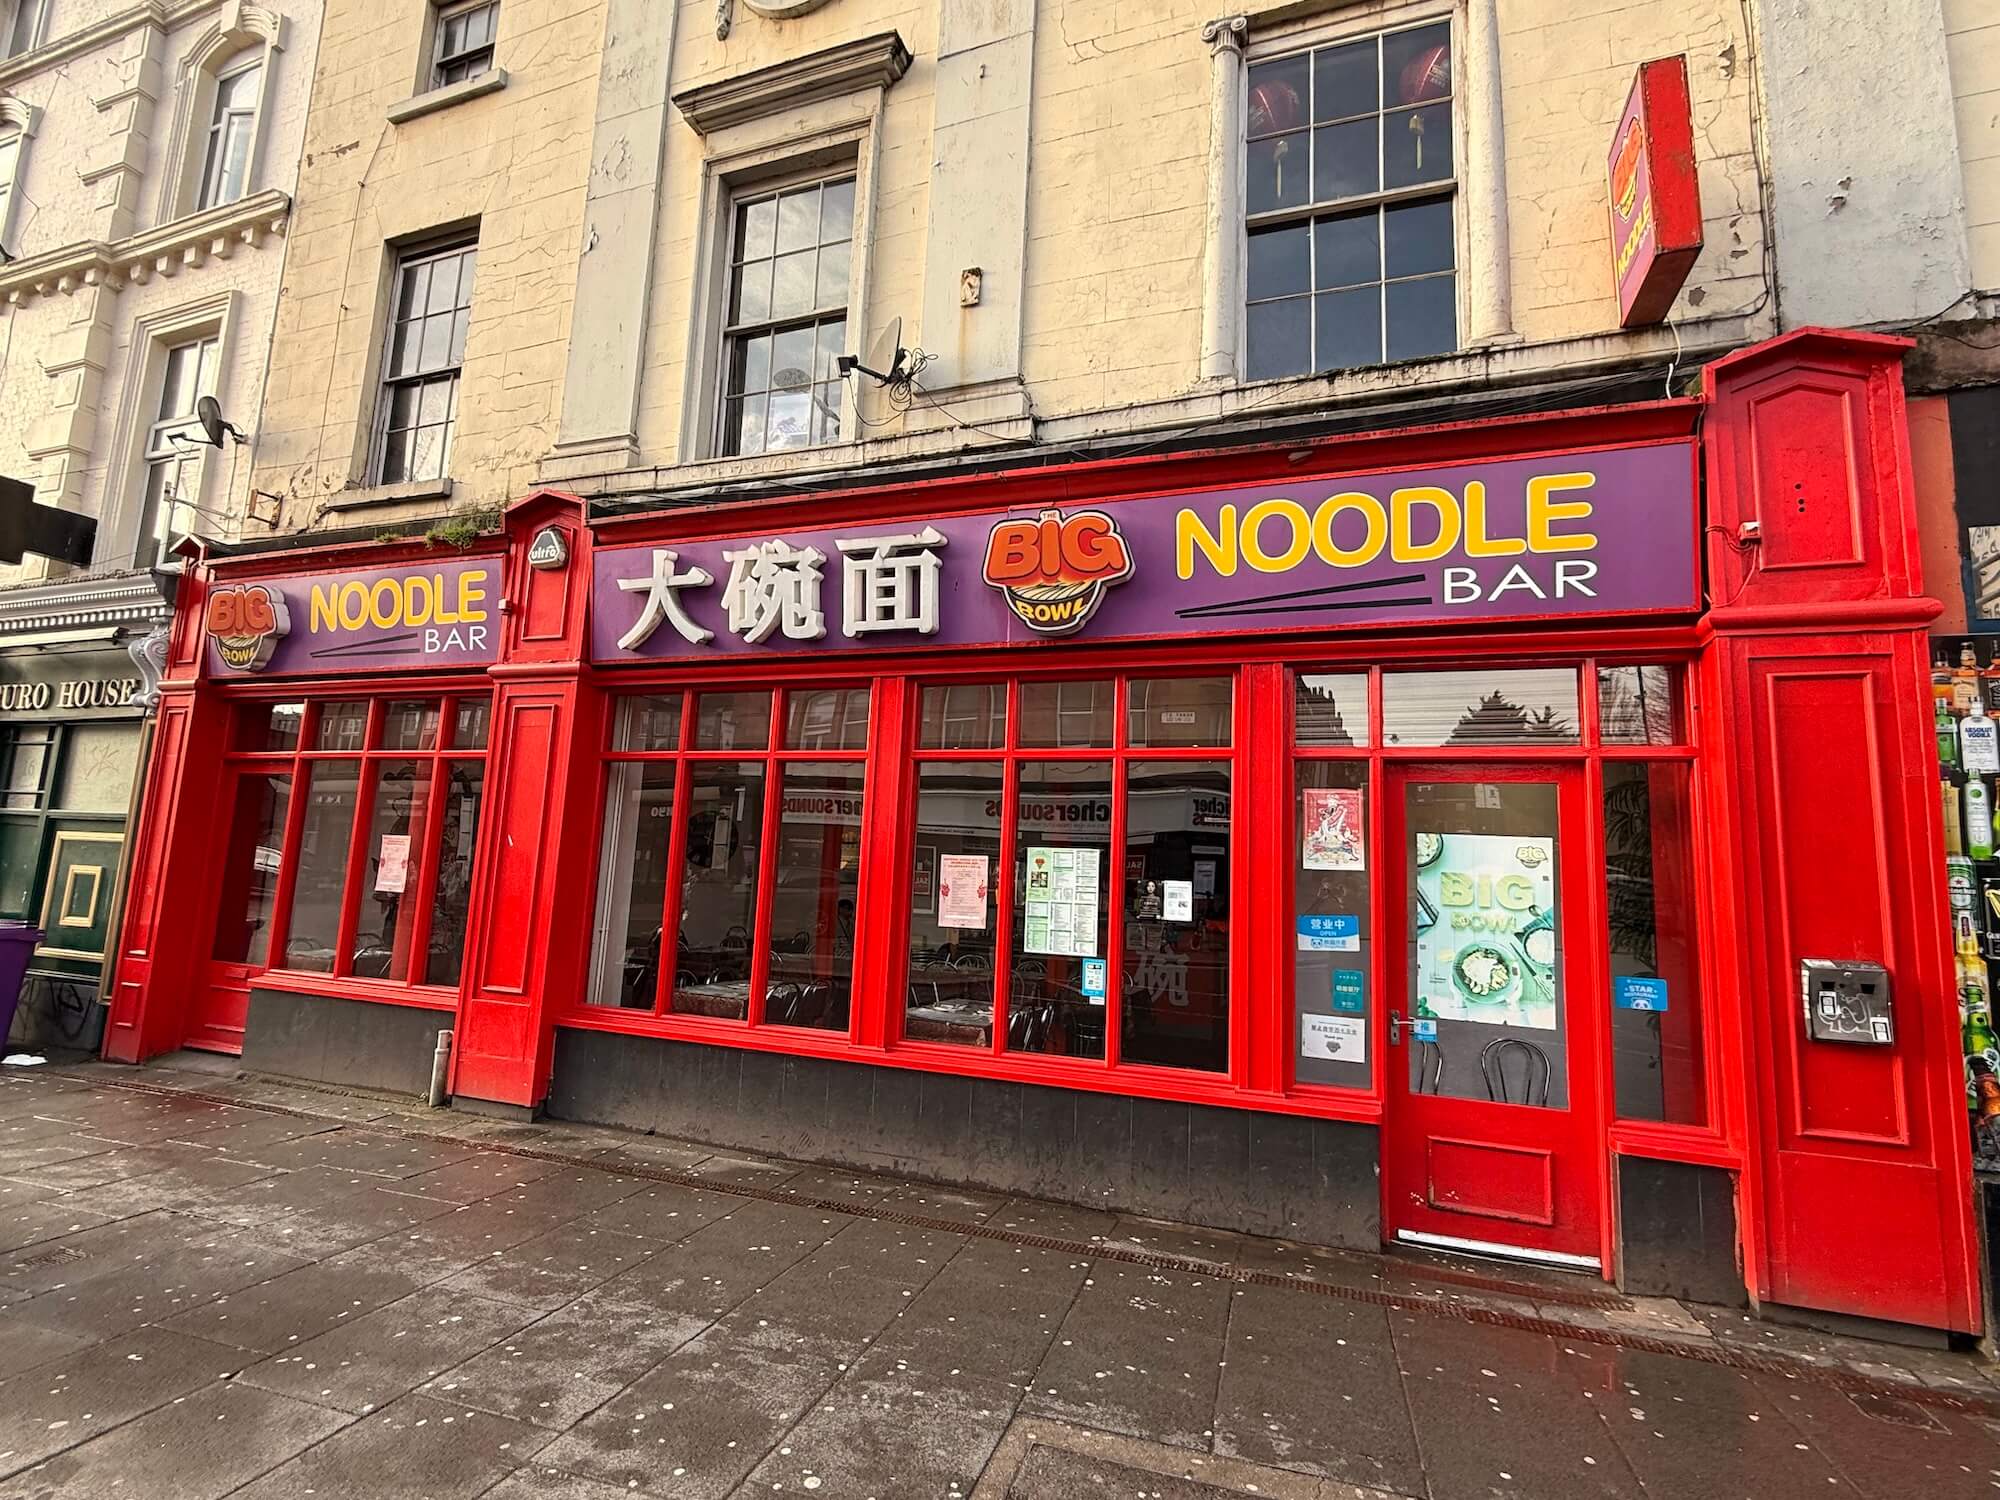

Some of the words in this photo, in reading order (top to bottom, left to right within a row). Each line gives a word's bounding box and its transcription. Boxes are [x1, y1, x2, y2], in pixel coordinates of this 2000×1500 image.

[1617, 194, 1650, 281] NOODLE
[1042, 511, 1058, 519] THE
[1175, 471, 1598, 581] NOODLE
[987, 514, 1125, 580] BIG
[616, 525, 949, 650] 大碗面
[1443, 558, 1598, 604] BAR
[208, 588, 273, 632] BIG
[310, 570, 488, 634] NOODLE
[1015, 597, 1088, 622] BOWL
[423, 625, 488, 654] BAR
[0, 682, 50, 710] URO
[56, 678, 136, 708] HOUSE
[1518, 847, 1545, 861] BIG
[1440, 871, 1536, 910] BIG
[1311, 918, 1345, 930] 营业中
[1628, 984, 1654, 994] STAR
